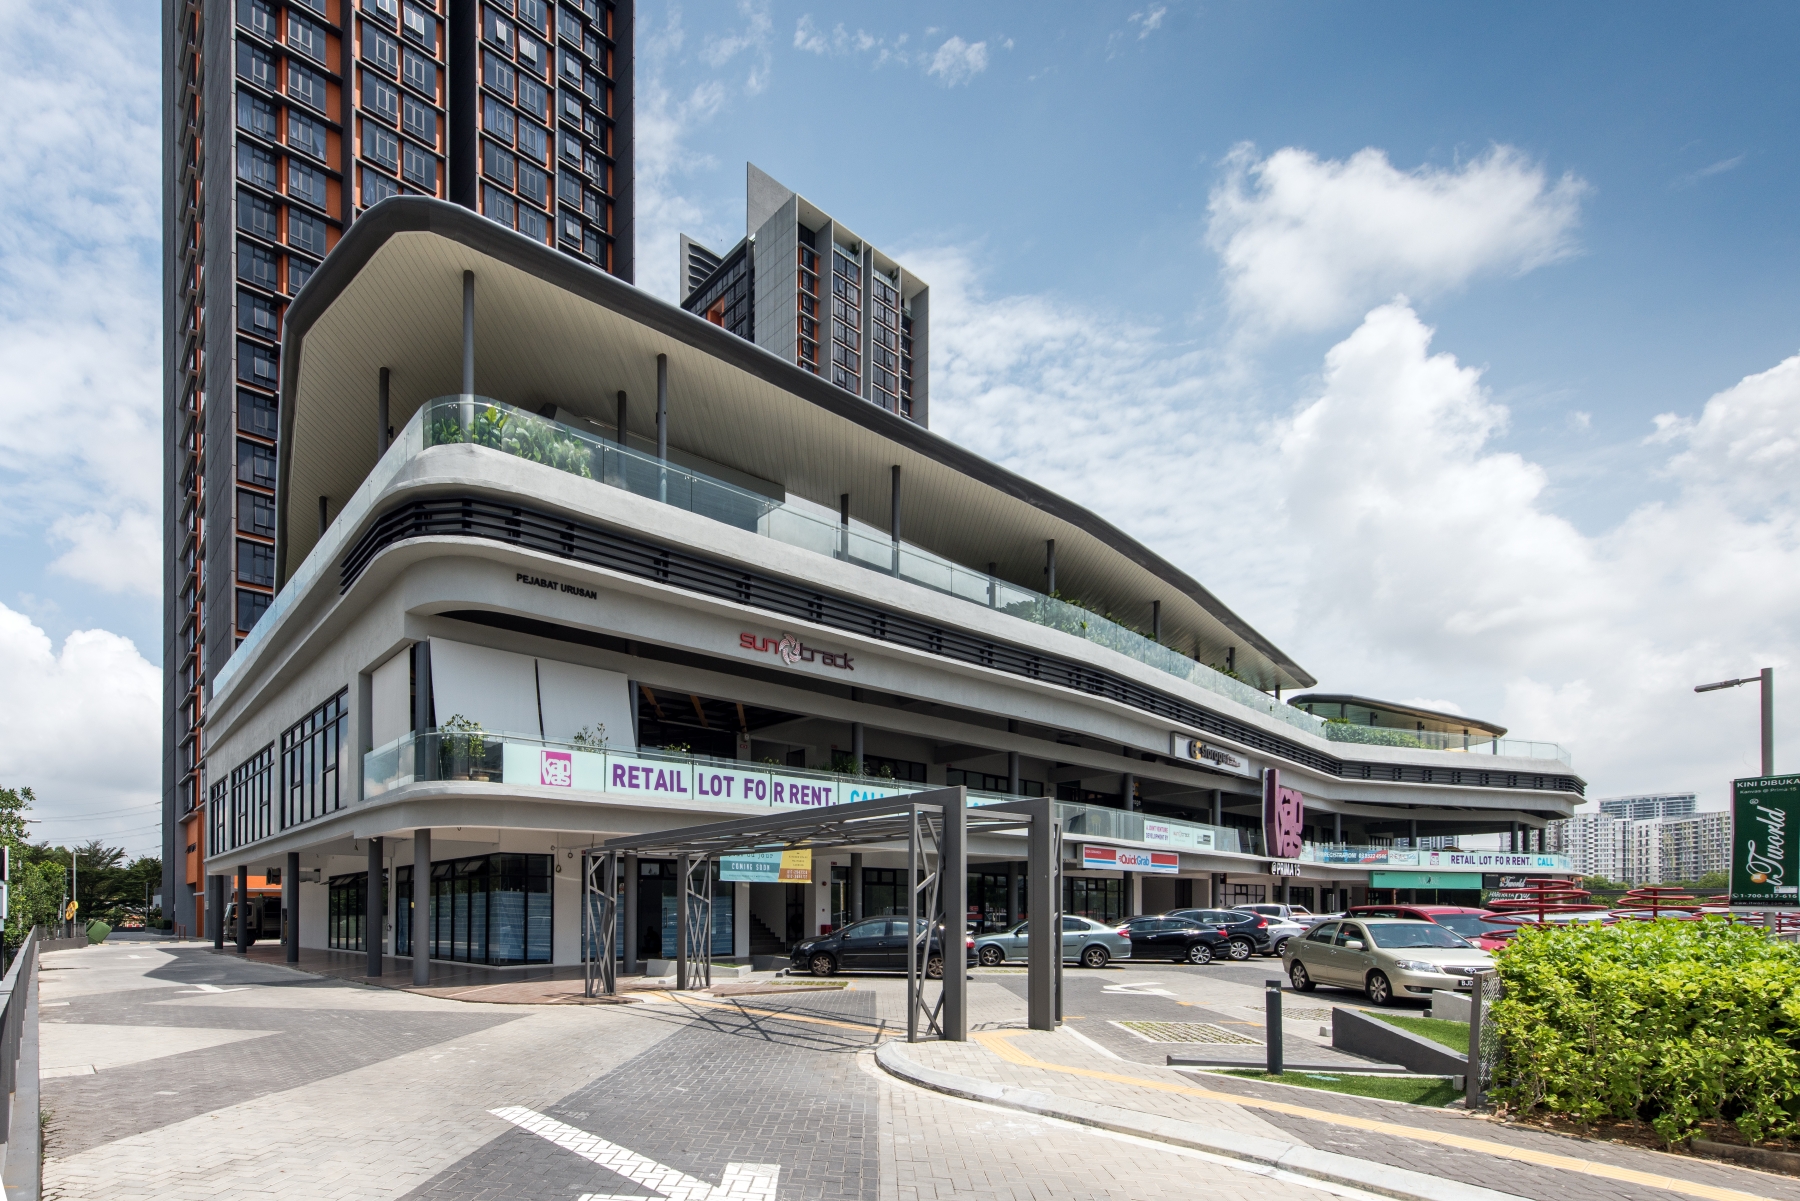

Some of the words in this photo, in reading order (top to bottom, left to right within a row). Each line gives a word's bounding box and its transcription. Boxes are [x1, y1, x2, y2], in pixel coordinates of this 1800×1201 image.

[516, 573, 558, 590] PEJABAT
[560, 583, 597, 600] URUSAN
[612, 763, 687, 793] RETAIL
[698, 772, 734, 798] LOT
[1760, 778, 1800, 787] DIBUKA
[1450, 855, 1476, 865] RETAIL
[1479, 856, 1492, 865] LOT
[1512, 857, 1532, 866] RENT.
[1537, 857, 1554, 866] CALL
[731, 862, 753, 871] COMING
